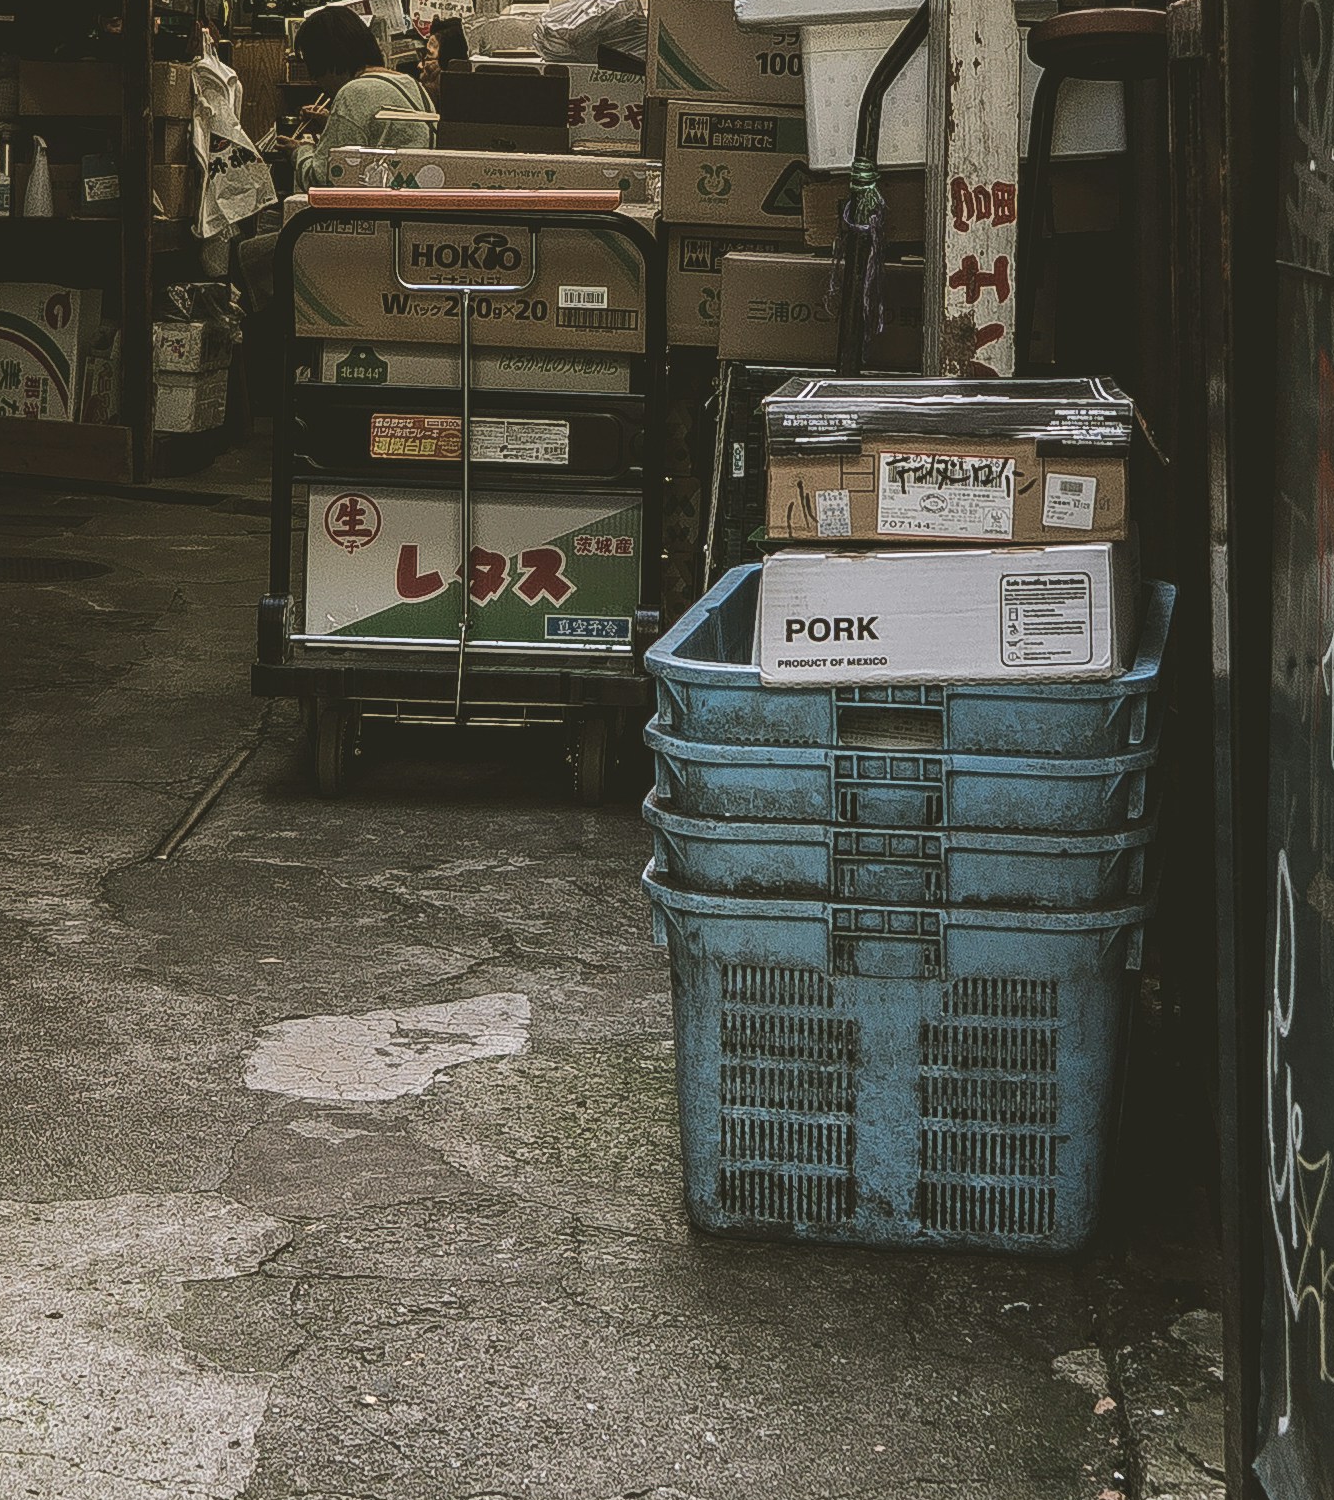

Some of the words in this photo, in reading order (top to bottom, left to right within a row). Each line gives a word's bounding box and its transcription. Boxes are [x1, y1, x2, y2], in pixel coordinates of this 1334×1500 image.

[331, 498, 373, 538] 生
[574, 536, 633, 557] 茨城産
[397, 544, 575, 606] レタス
[555, 618, 618, 637] 真空予冷
[784, 615, 880, 644] PORK
[777, 658, 827, 669] PRODUCT
[830, 658, 845, 668] OF
[847, 657, 888, 667] MEXICO
